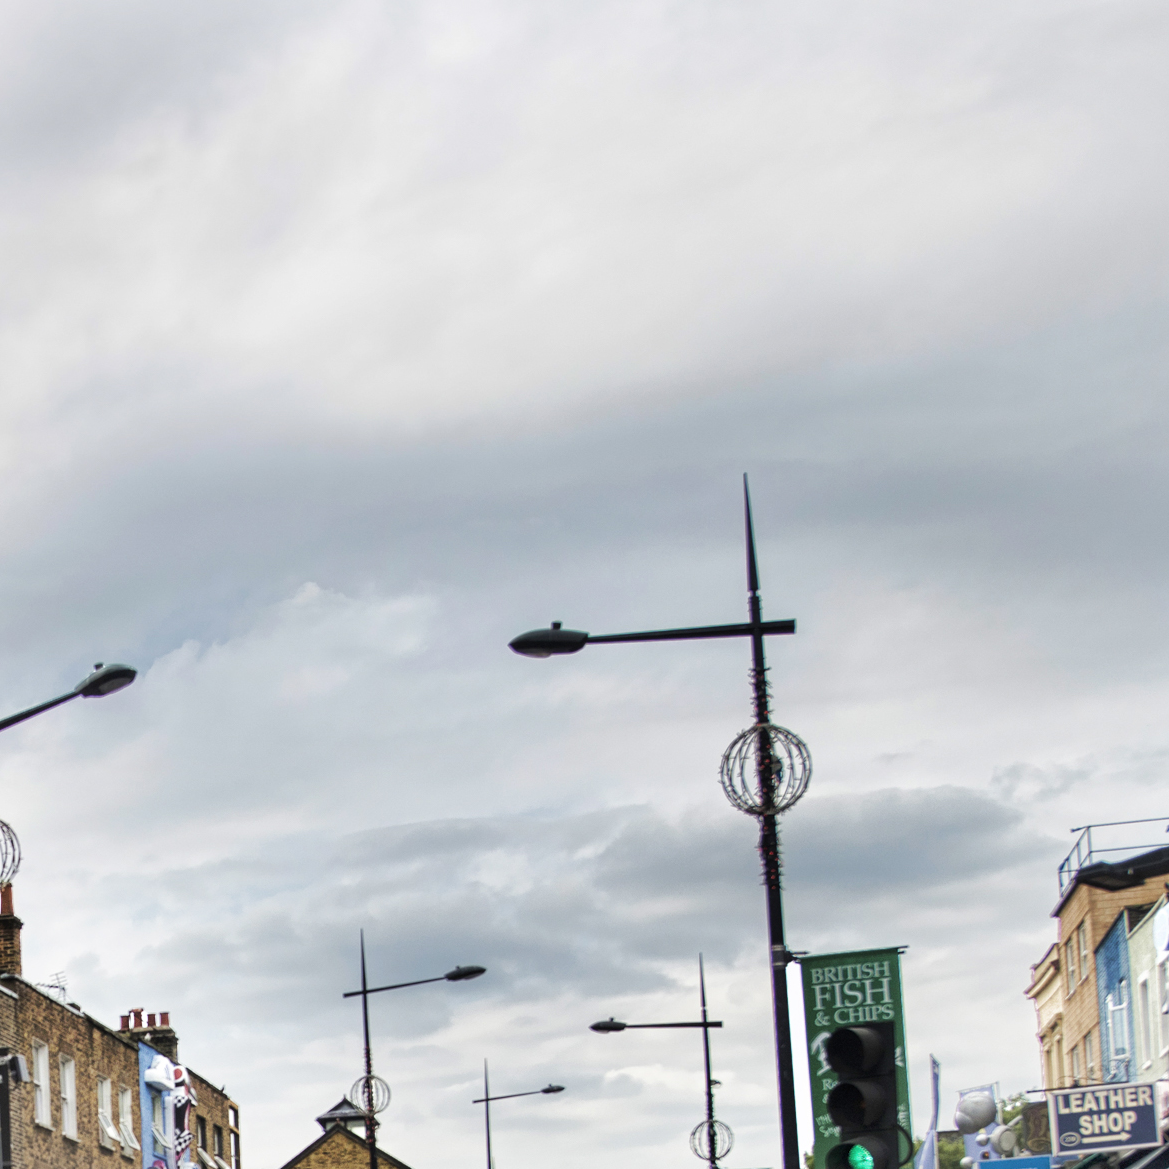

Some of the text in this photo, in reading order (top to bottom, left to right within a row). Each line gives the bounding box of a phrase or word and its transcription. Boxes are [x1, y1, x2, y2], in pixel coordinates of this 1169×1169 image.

[810, 961, 891, 984] BRITISH
[811, 977, 893, 1010] FISH
[814, 1004, 895, 1027] & CHIPS
[1057, 1086, 1153, 1115] LEATHER
[1078, 1110, 1137, 1135] SHOP
